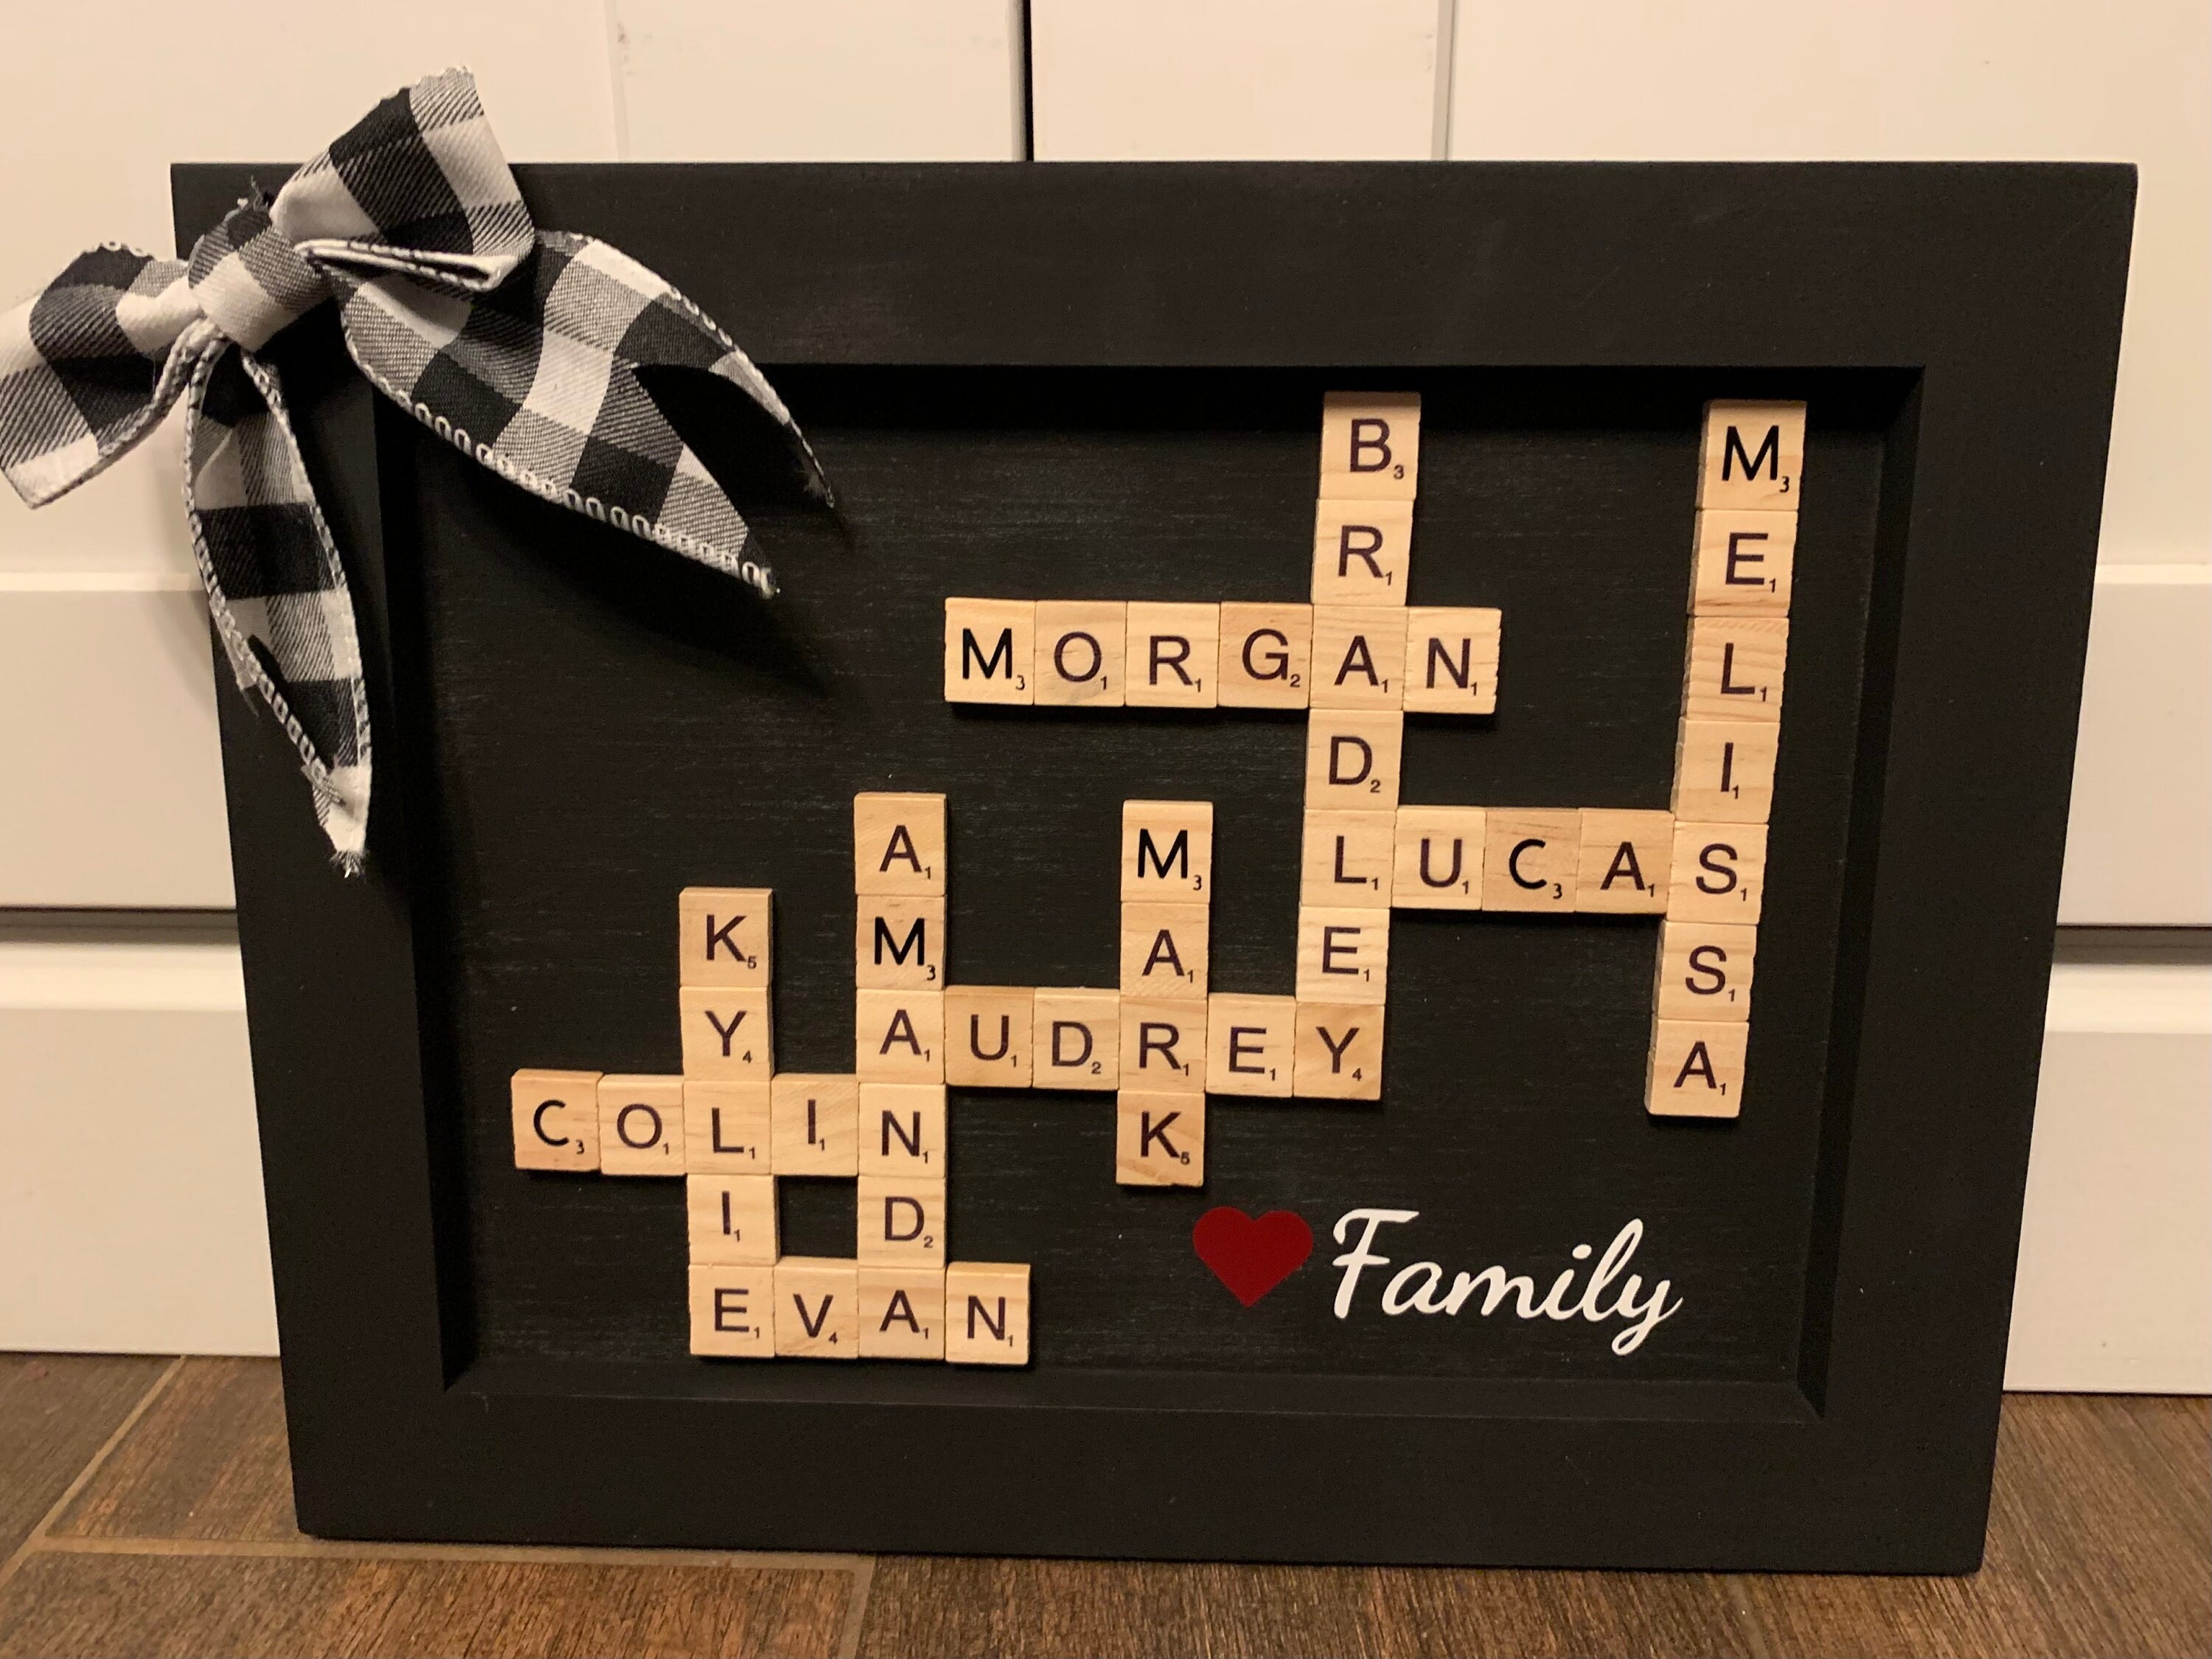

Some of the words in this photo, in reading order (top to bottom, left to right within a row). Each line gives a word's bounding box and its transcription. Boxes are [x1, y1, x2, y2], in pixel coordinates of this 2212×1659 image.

[961, 627, 1472, 689] MORGAN
[1315, 418, 1393, 1074] BRADLEY
[1672, 424, 1780, 1090] MELISSA
[1333, 834, 1739, 896] LUCAS
[878, 1008, 1360, 1075] AUDREY
[1136, 827, 1189, 1159] MARK
[532, 1098, 922, 1158] COLIN
[703, 914, 751, 1333] KYLIE
[873, 824, 926, 1334] AMANDA
[713, 1287, 1006, 1341] EVAN
[1332, 1207, 1683, 1355] Family
